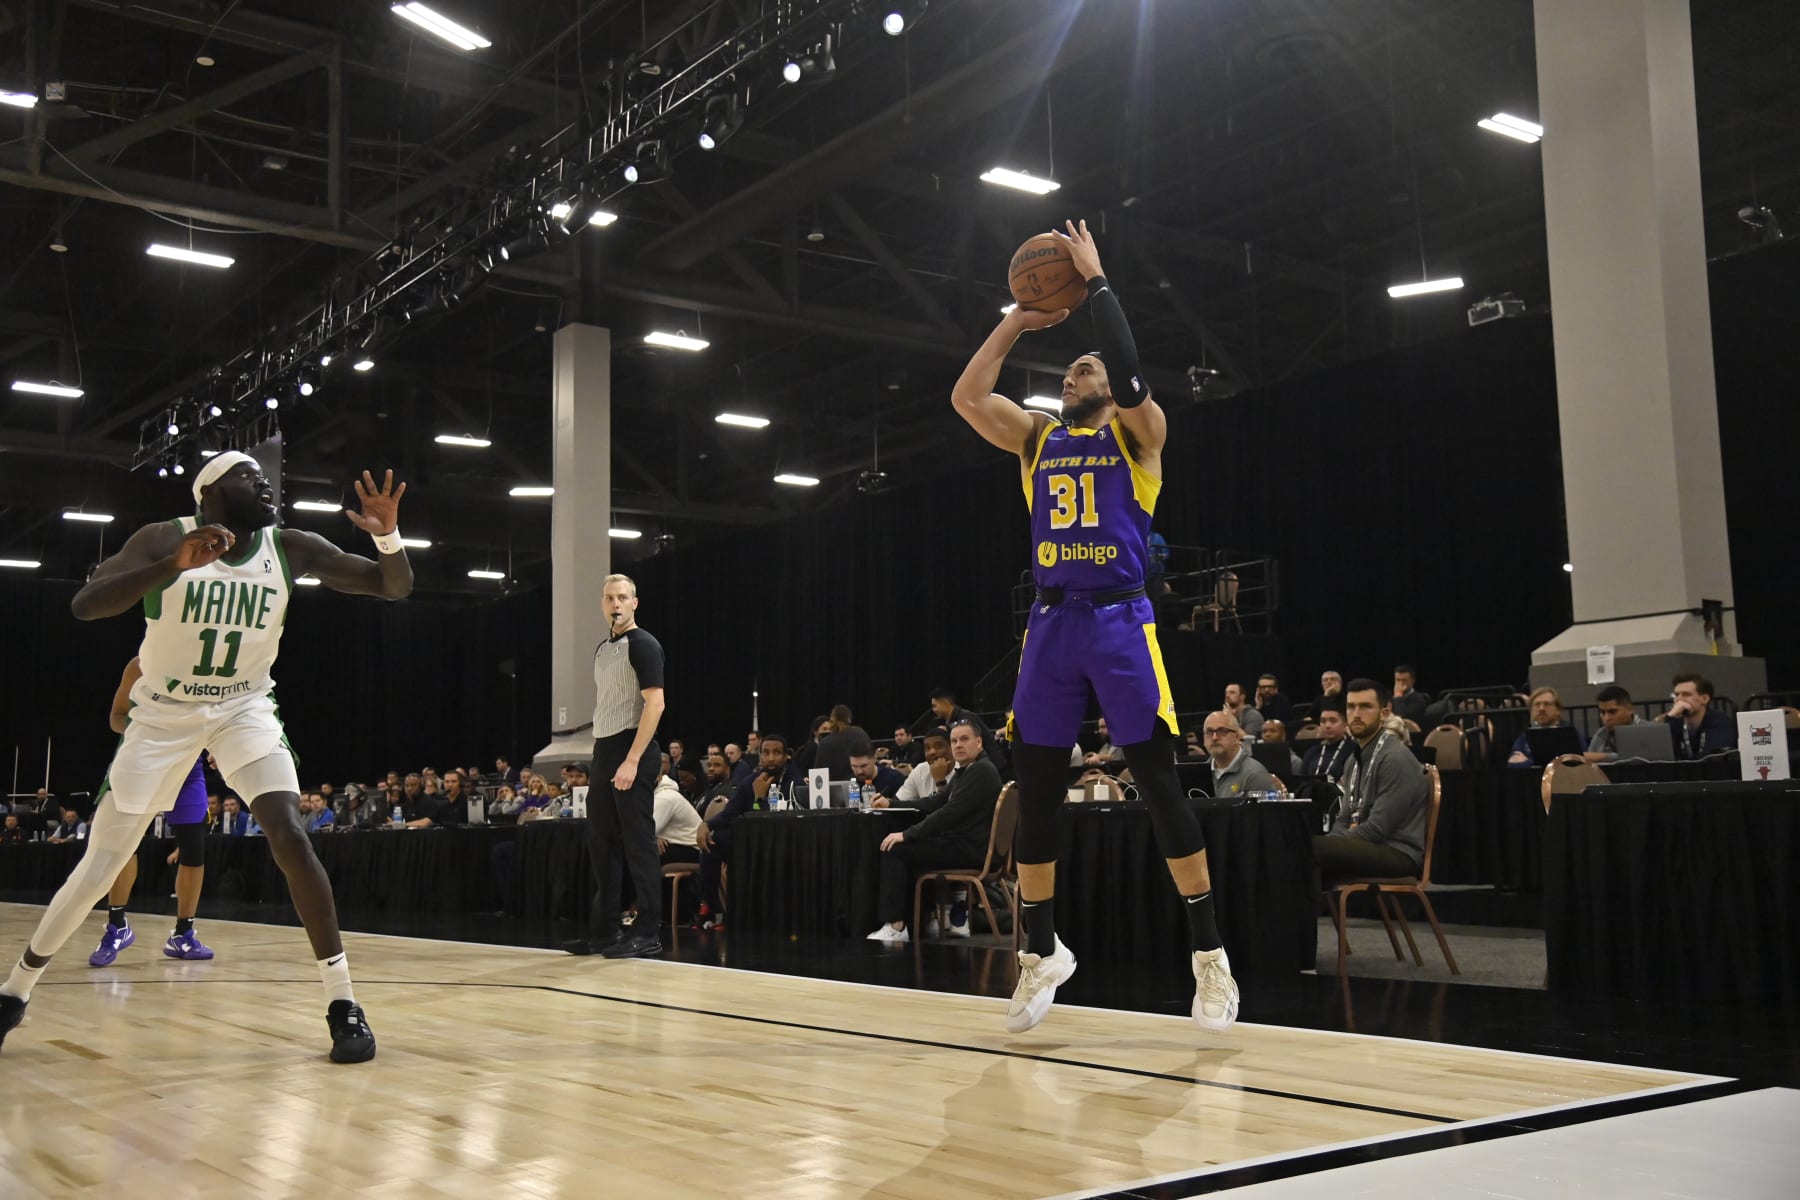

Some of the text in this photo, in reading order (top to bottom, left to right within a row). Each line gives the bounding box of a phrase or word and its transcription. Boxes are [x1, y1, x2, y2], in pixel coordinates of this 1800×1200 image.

[1084, 456, 1120, 466] BAY
[1048, 472, 1099, 529] 31
[1061, 543, 1117, 565] bibigo
[181, 580, 277, 629] MAINE
[192, 628, 242, 677] 11
[183, 679, 251, 699] vistaprint
